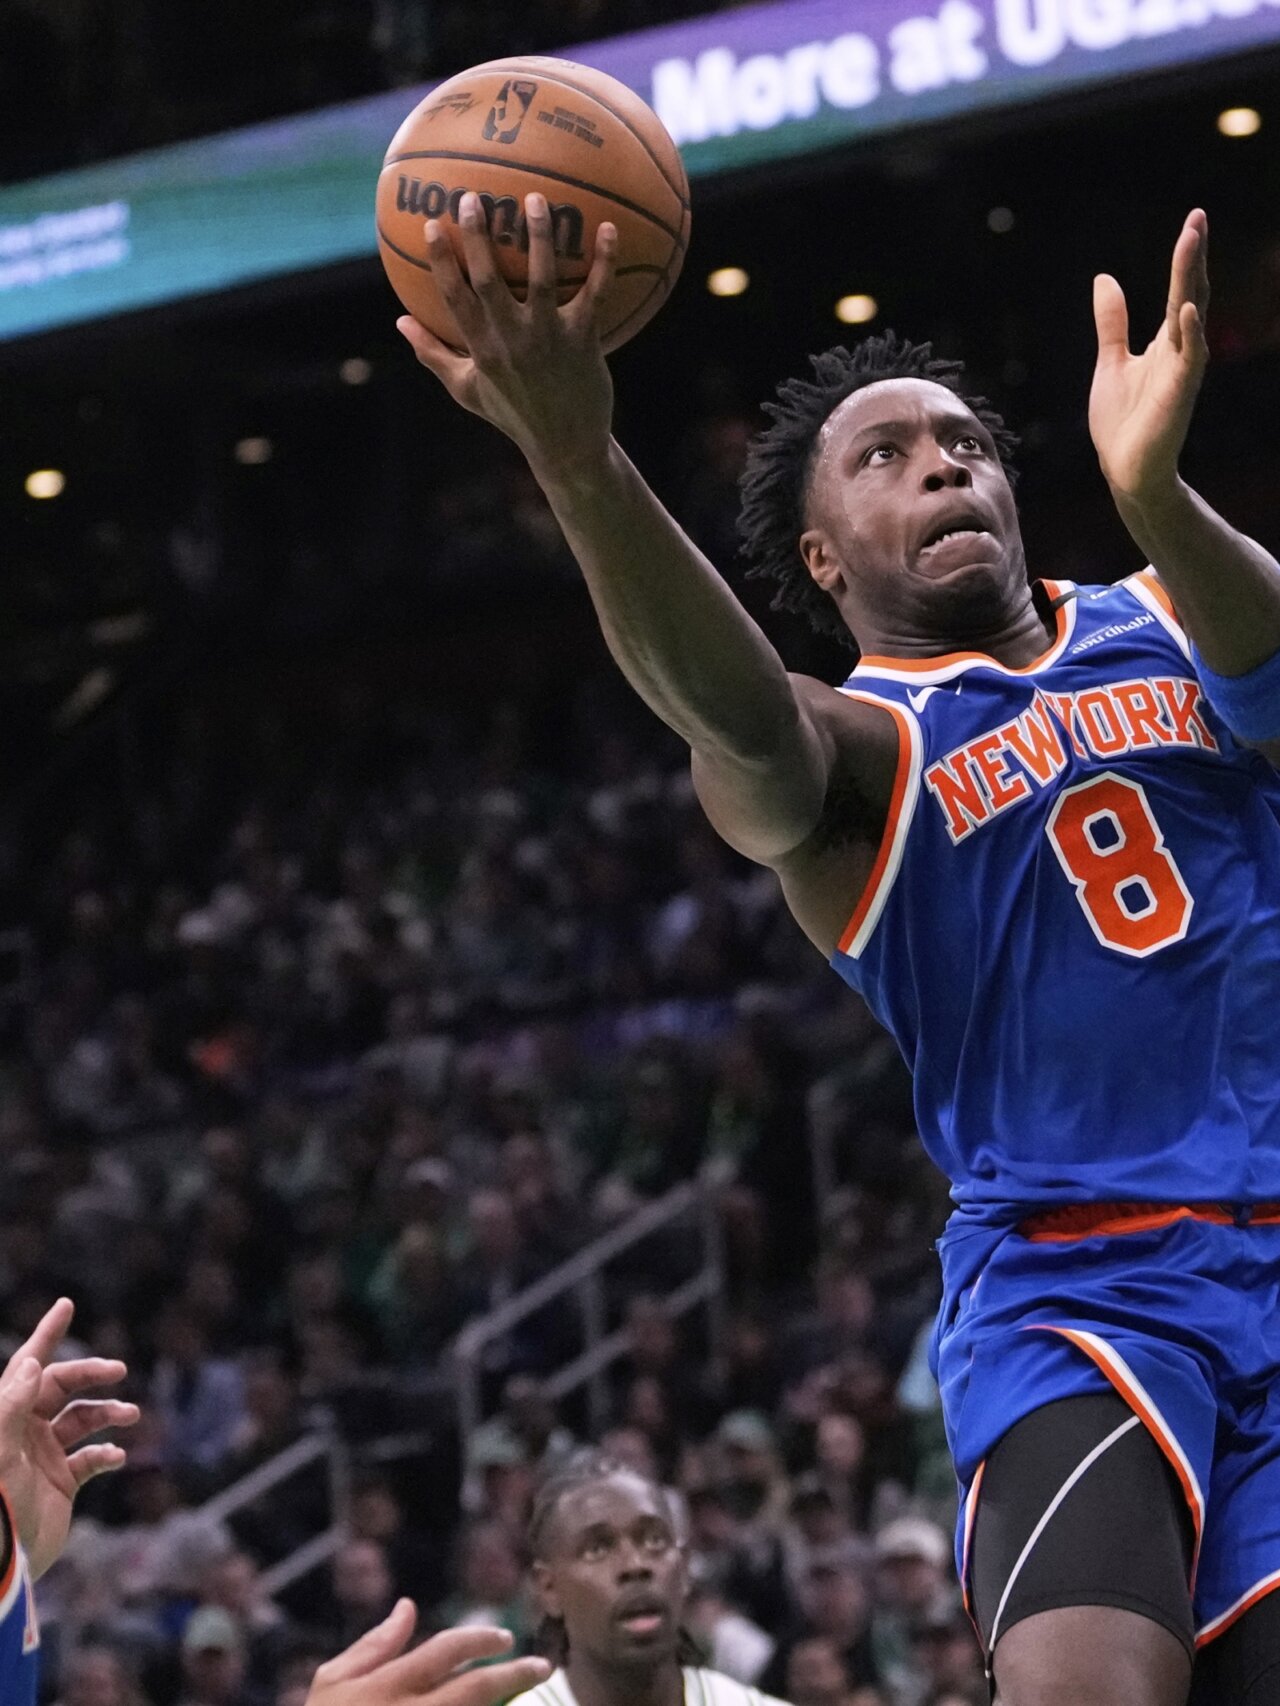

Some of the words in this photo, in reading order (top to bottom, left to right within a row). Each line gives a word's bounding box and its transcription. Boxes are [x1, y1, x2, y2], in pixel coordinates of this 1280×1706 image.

[652, 33, 880, 143] More
[887, 0, 988, 95] at
[1072, 633, 1105, 655] abu
[1105, 612, 1156, 638] dhabi
[924, 689, 1068, 846] NEW
[1037, 676, 1221, 761] YORK
[1045, 771, 1194, 958] 8
